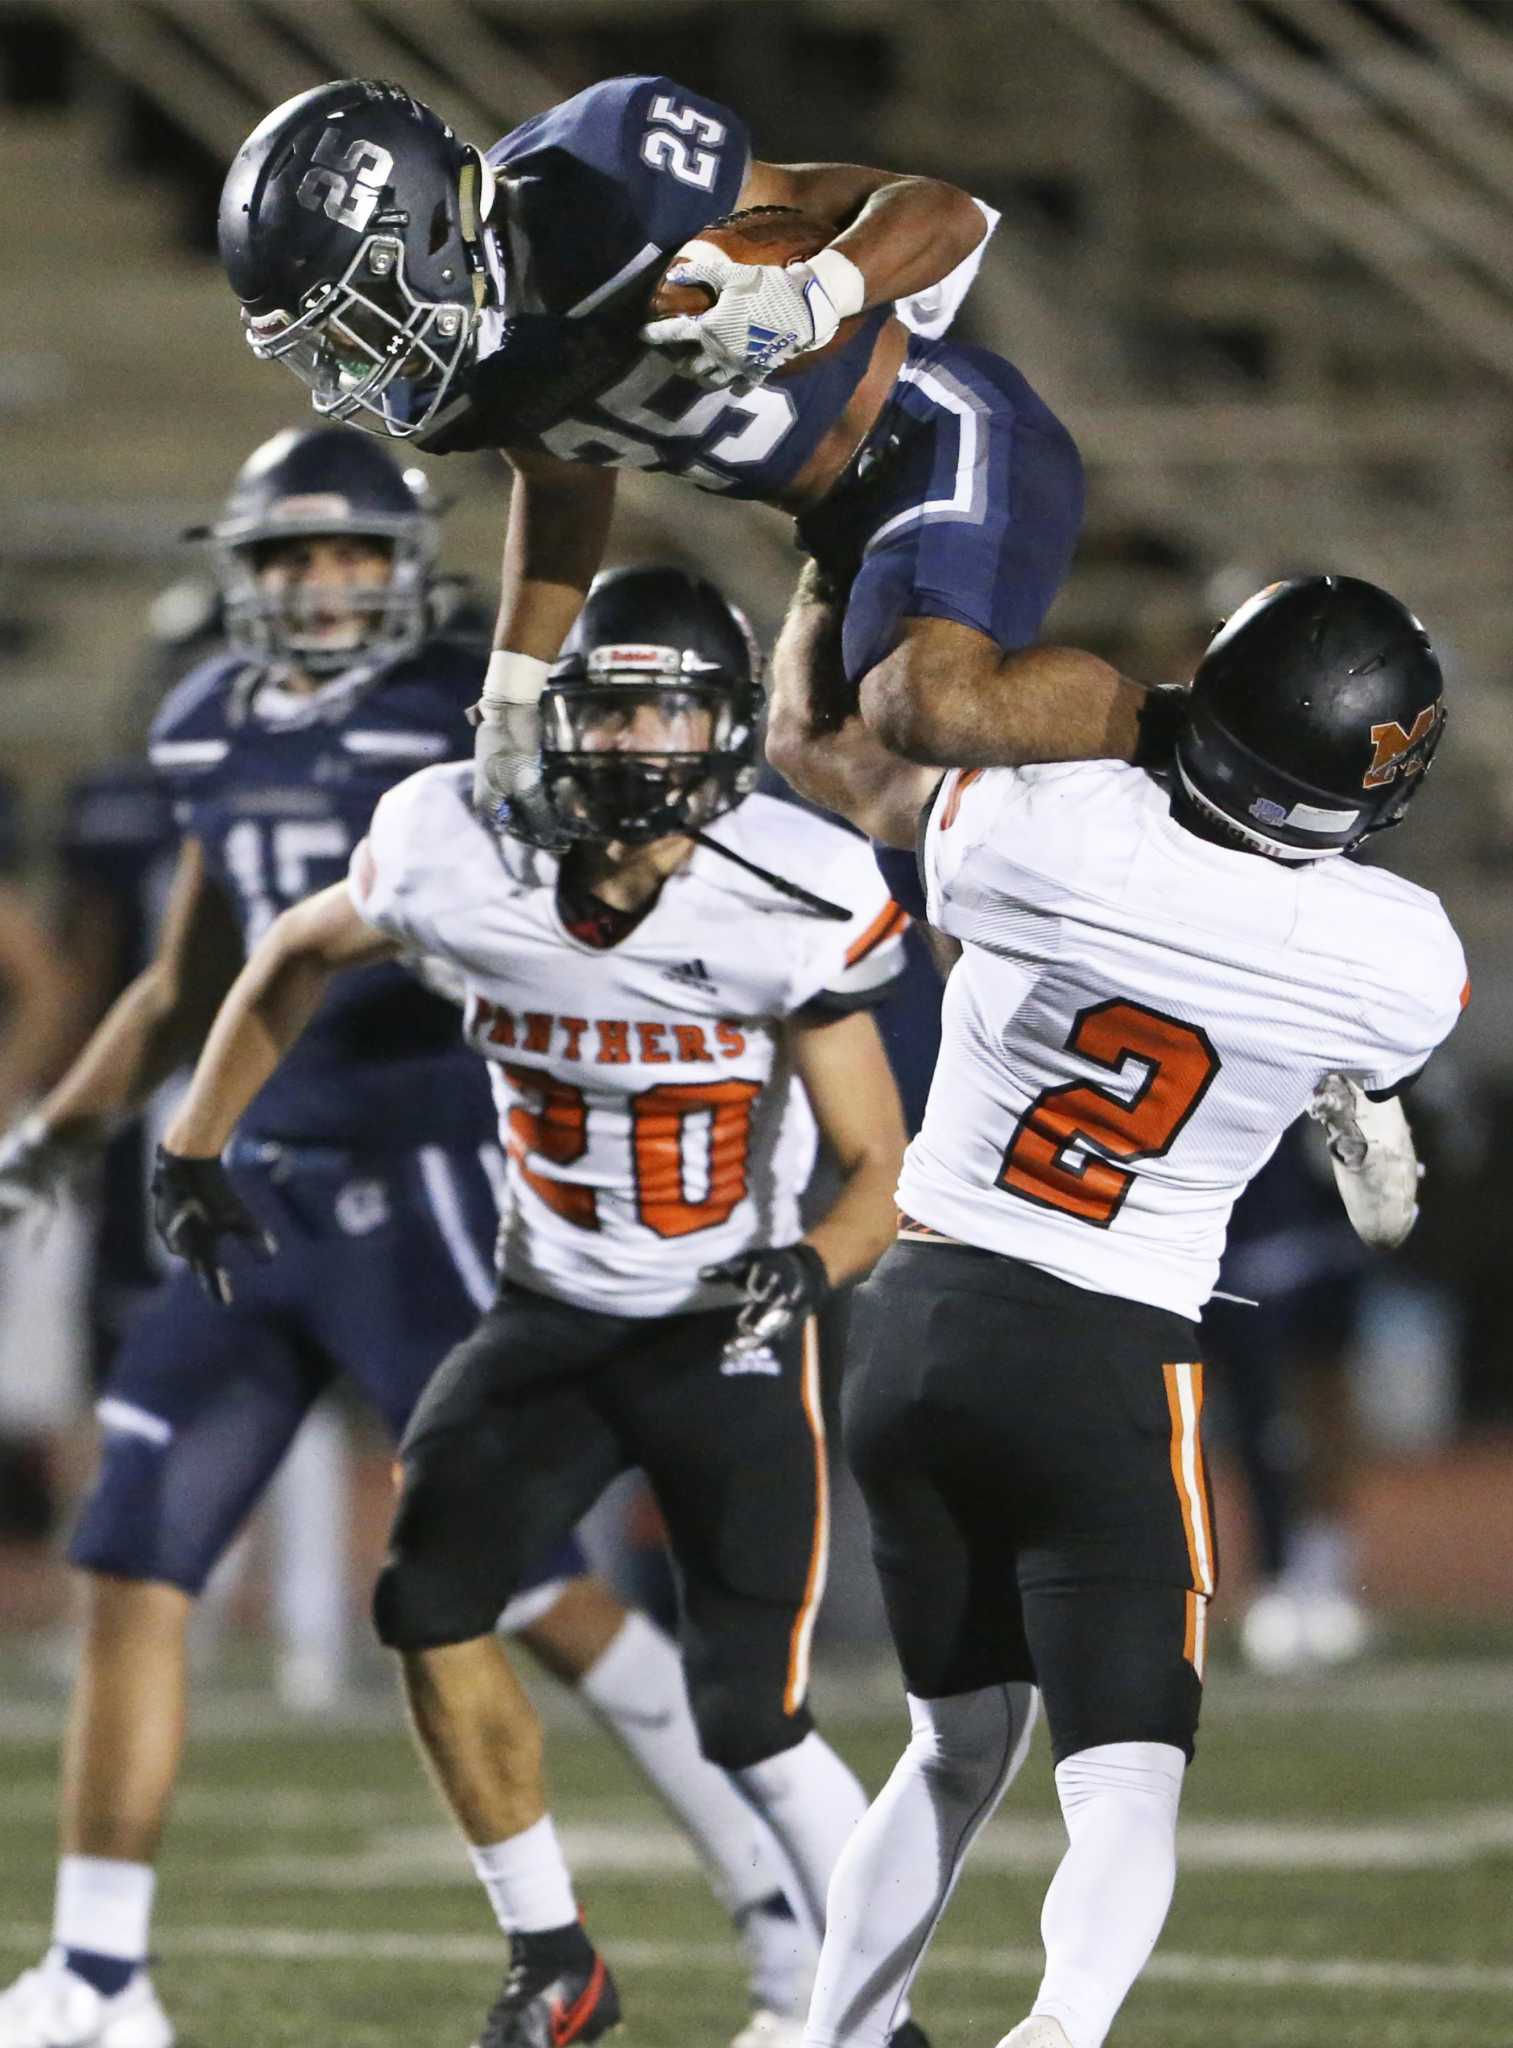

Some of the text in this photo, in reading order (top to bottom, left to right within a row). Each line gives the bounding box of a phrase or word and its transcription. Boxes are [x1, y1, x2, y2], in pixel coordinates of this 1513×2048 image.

[296, 127, 394, 233] 25
[641, 94, 727, 194] 25
[472, 995, 747, 1064] PANTHERS
[501, 1060, 765, 1239] 20
[994, 996, 1222, 1230] 2
